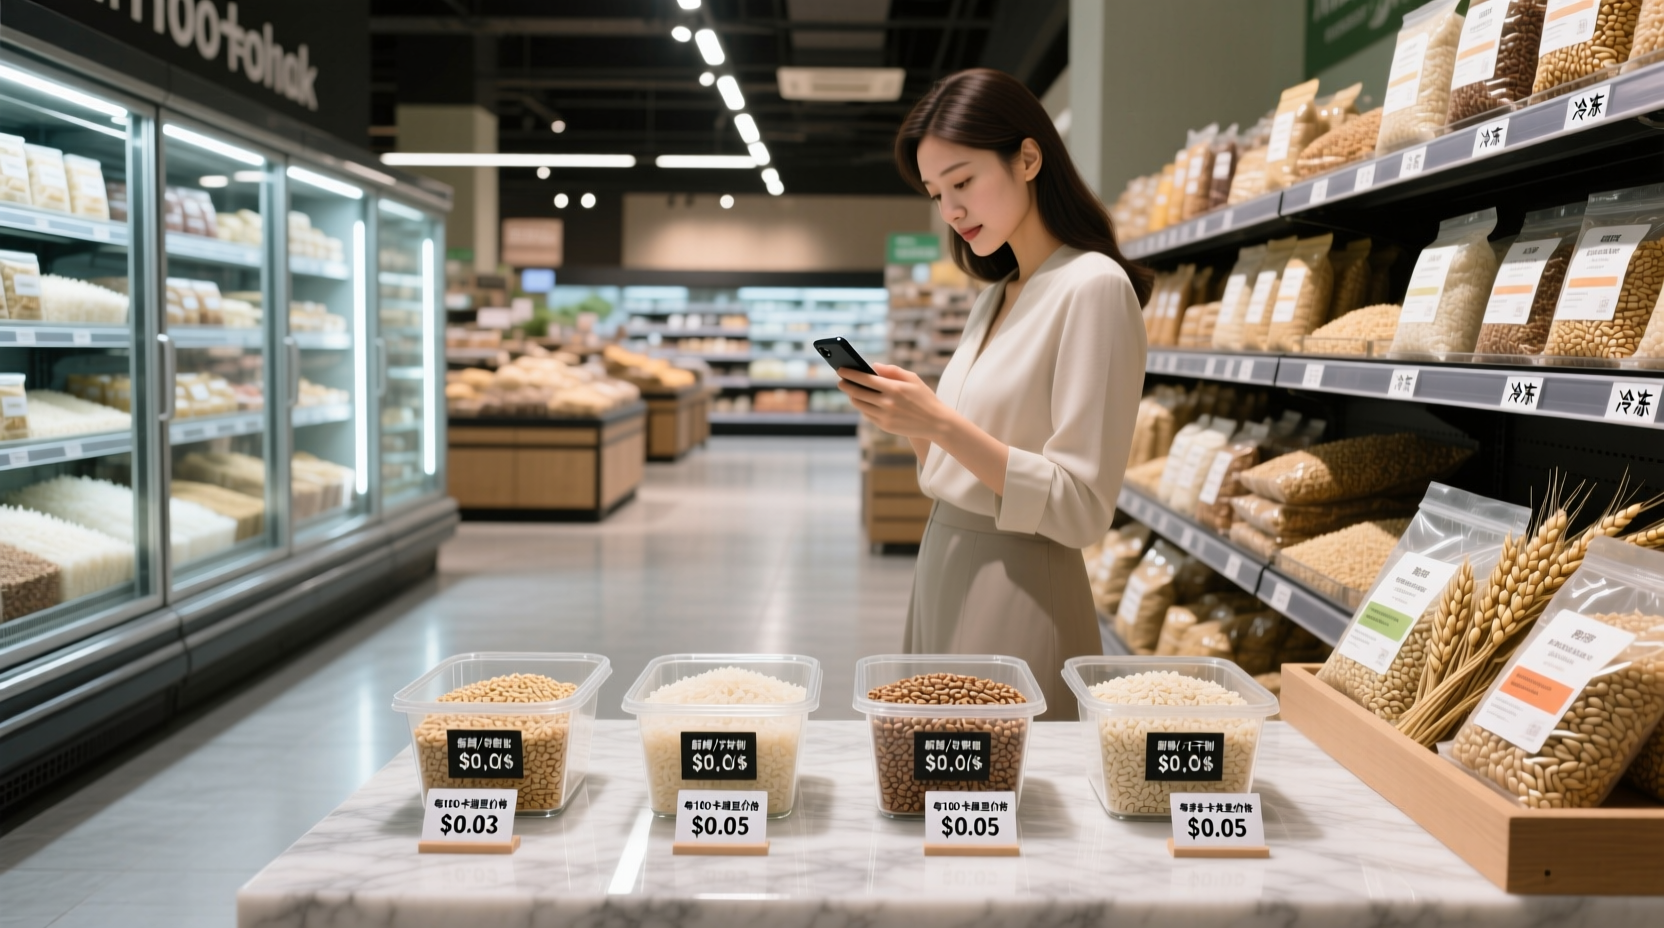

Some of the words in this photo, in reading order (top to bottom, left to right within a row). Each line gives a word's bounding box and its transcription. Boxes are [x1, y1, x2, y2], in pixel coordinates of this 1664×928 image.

[1572, 92, 1606, 121] 冷冻
[1479, 126, 1504, 149] 冷冻
[1507, 381, 1538, 406] 冷冻
[1615, 388, 1654, 417] 冷冻
[440, 813, 499, 836] $0.03
[691, 814, 749, 838] $0.05
[941, 815, 1000, 839] $0.05
[1187, 816, 1247, 840] $0.05
